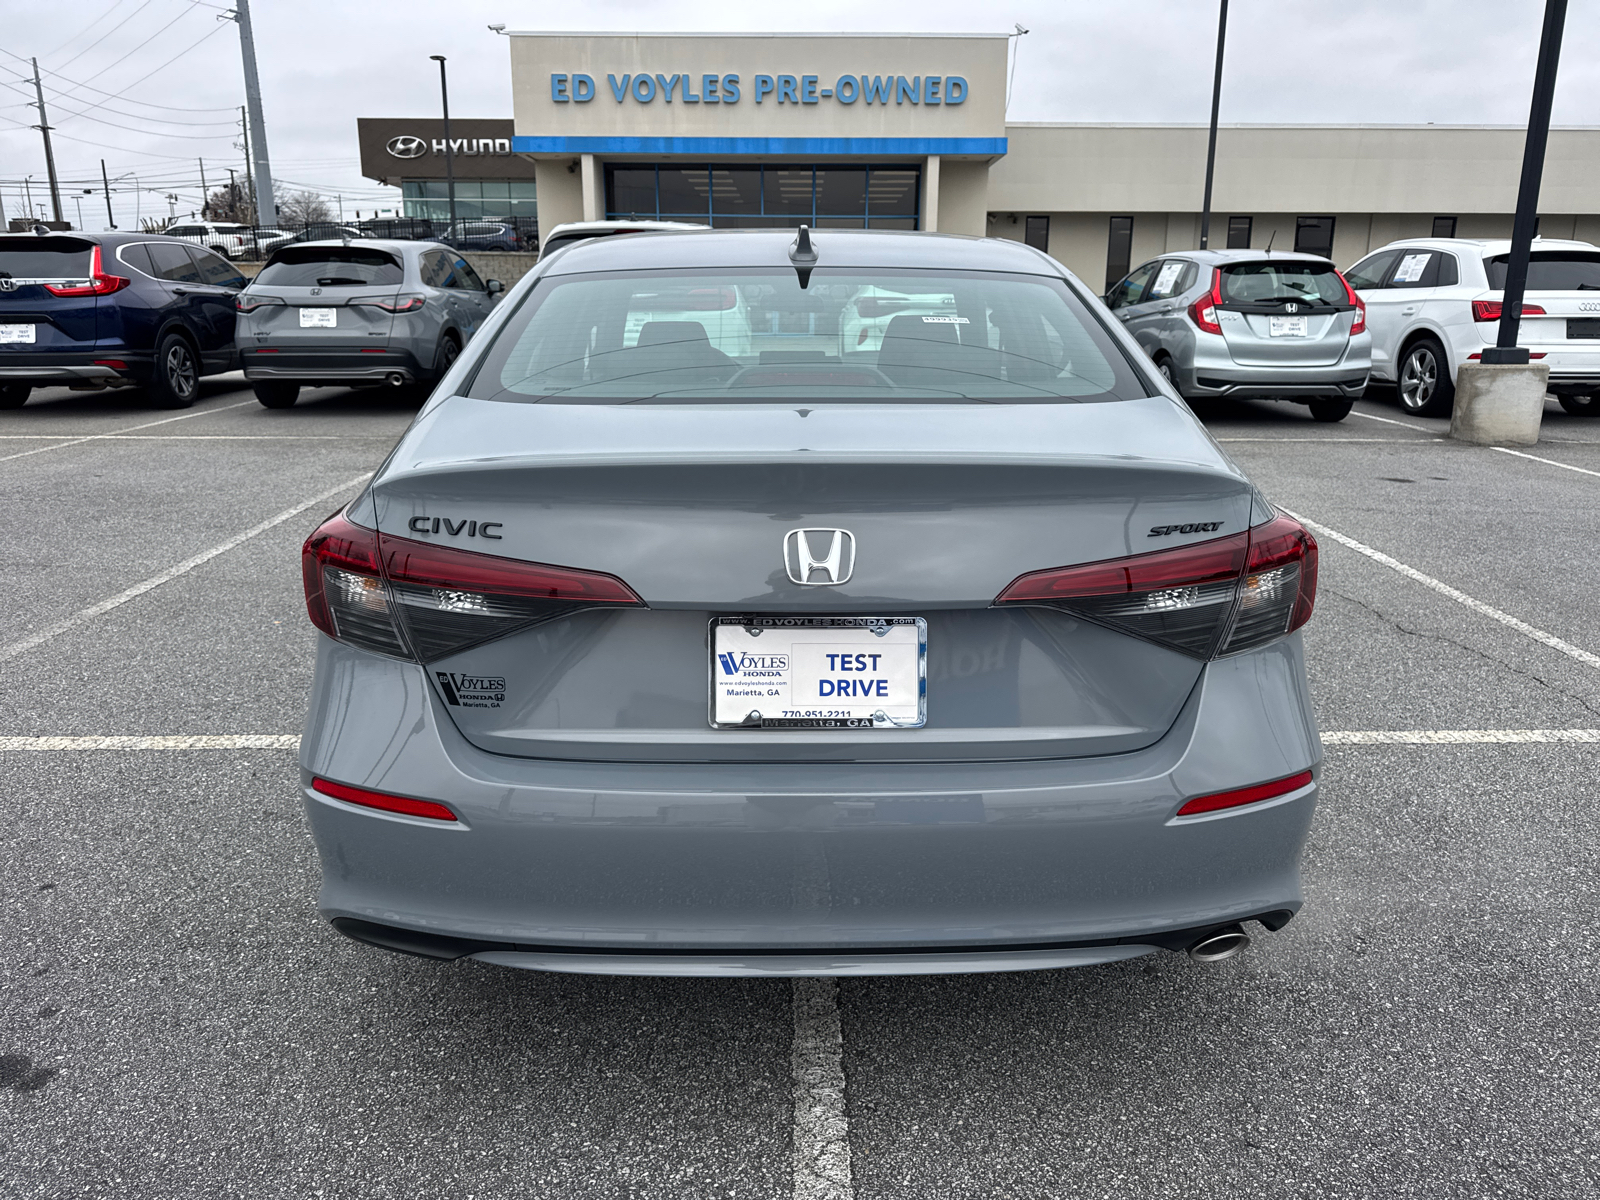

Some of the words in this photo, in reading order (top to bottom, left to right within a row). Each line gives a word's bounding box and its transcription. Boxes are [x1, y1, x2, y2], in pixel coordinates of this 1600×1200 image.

[550, 73, 596, 103] ED
[607, 73, 741, 103] VOYLES
[754, 74, 969, 105] PRE-OWNED
[431, 138, 512, 156] HYUND
[408, 516, 503, 539] CIVIC
[1147, 521, 1225, 537] SPORT
[826, 653, 882, 671] TEST
[440, 675, 449, 683] ED
[726, 688, 764, 697] Marietta,
[766, 688, 780, 697] GA
[819, 679, 889, 697] DRIVE
[462, 701, 490, 709] Marietta,
[782, 710, 851, 718] 770-951-2211
[847, 718, 871, 728] GA
